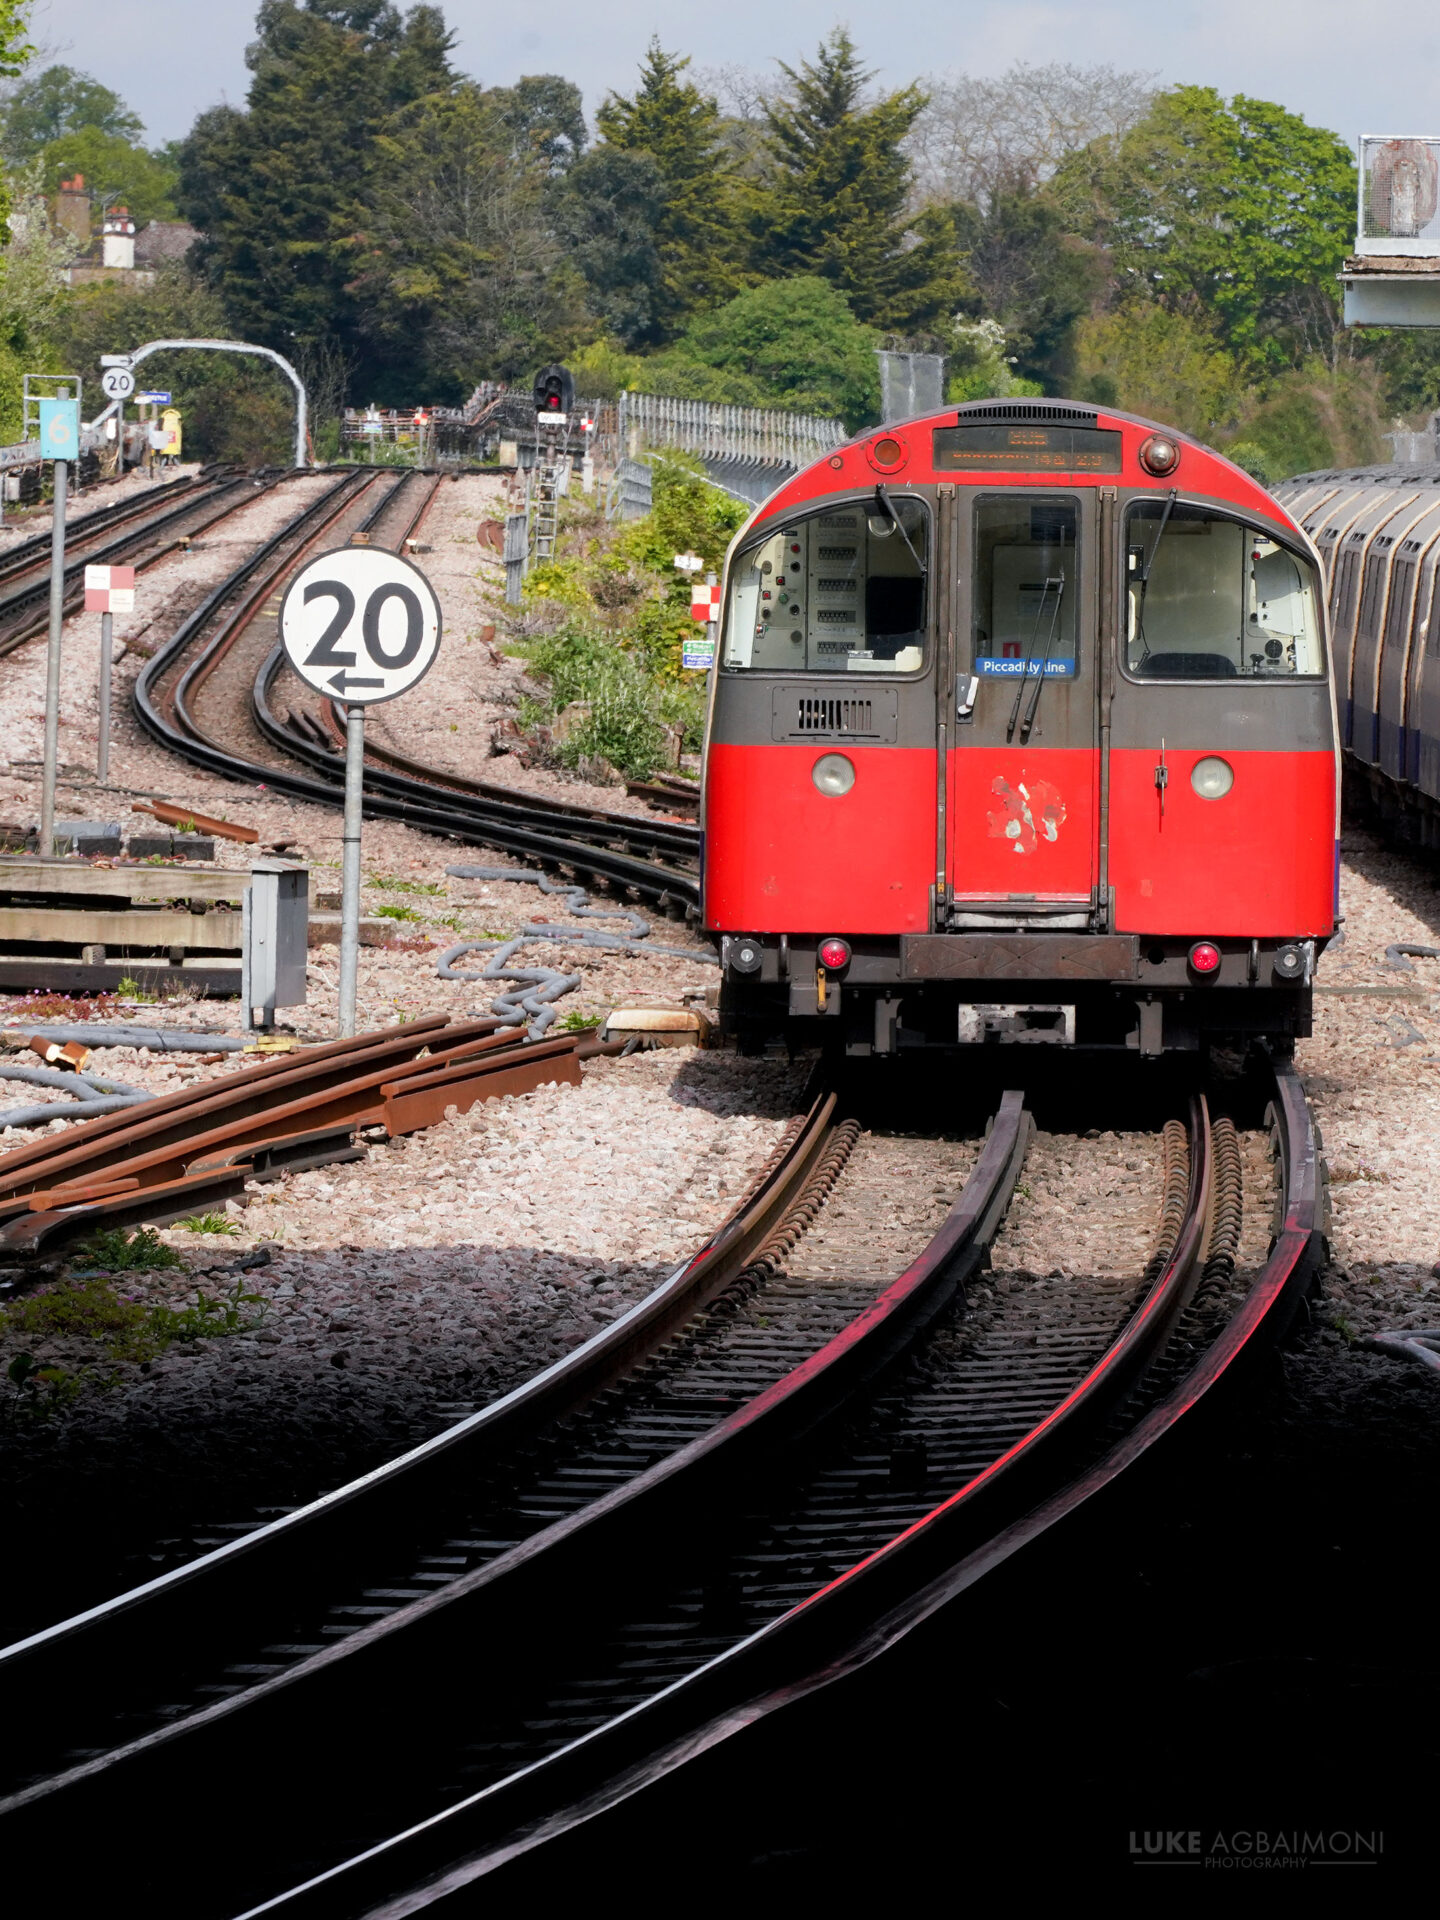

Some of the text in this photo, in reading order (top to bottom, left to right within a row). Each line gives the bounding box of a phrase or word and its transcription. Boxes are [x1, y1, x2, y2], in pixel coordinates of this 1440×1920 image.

[107, 375, 130, 391] 20
[48, 414, 70, 444] 6
[303, 580, 424, 669] 20
[984, 661, 1040, 674] Piccadily
